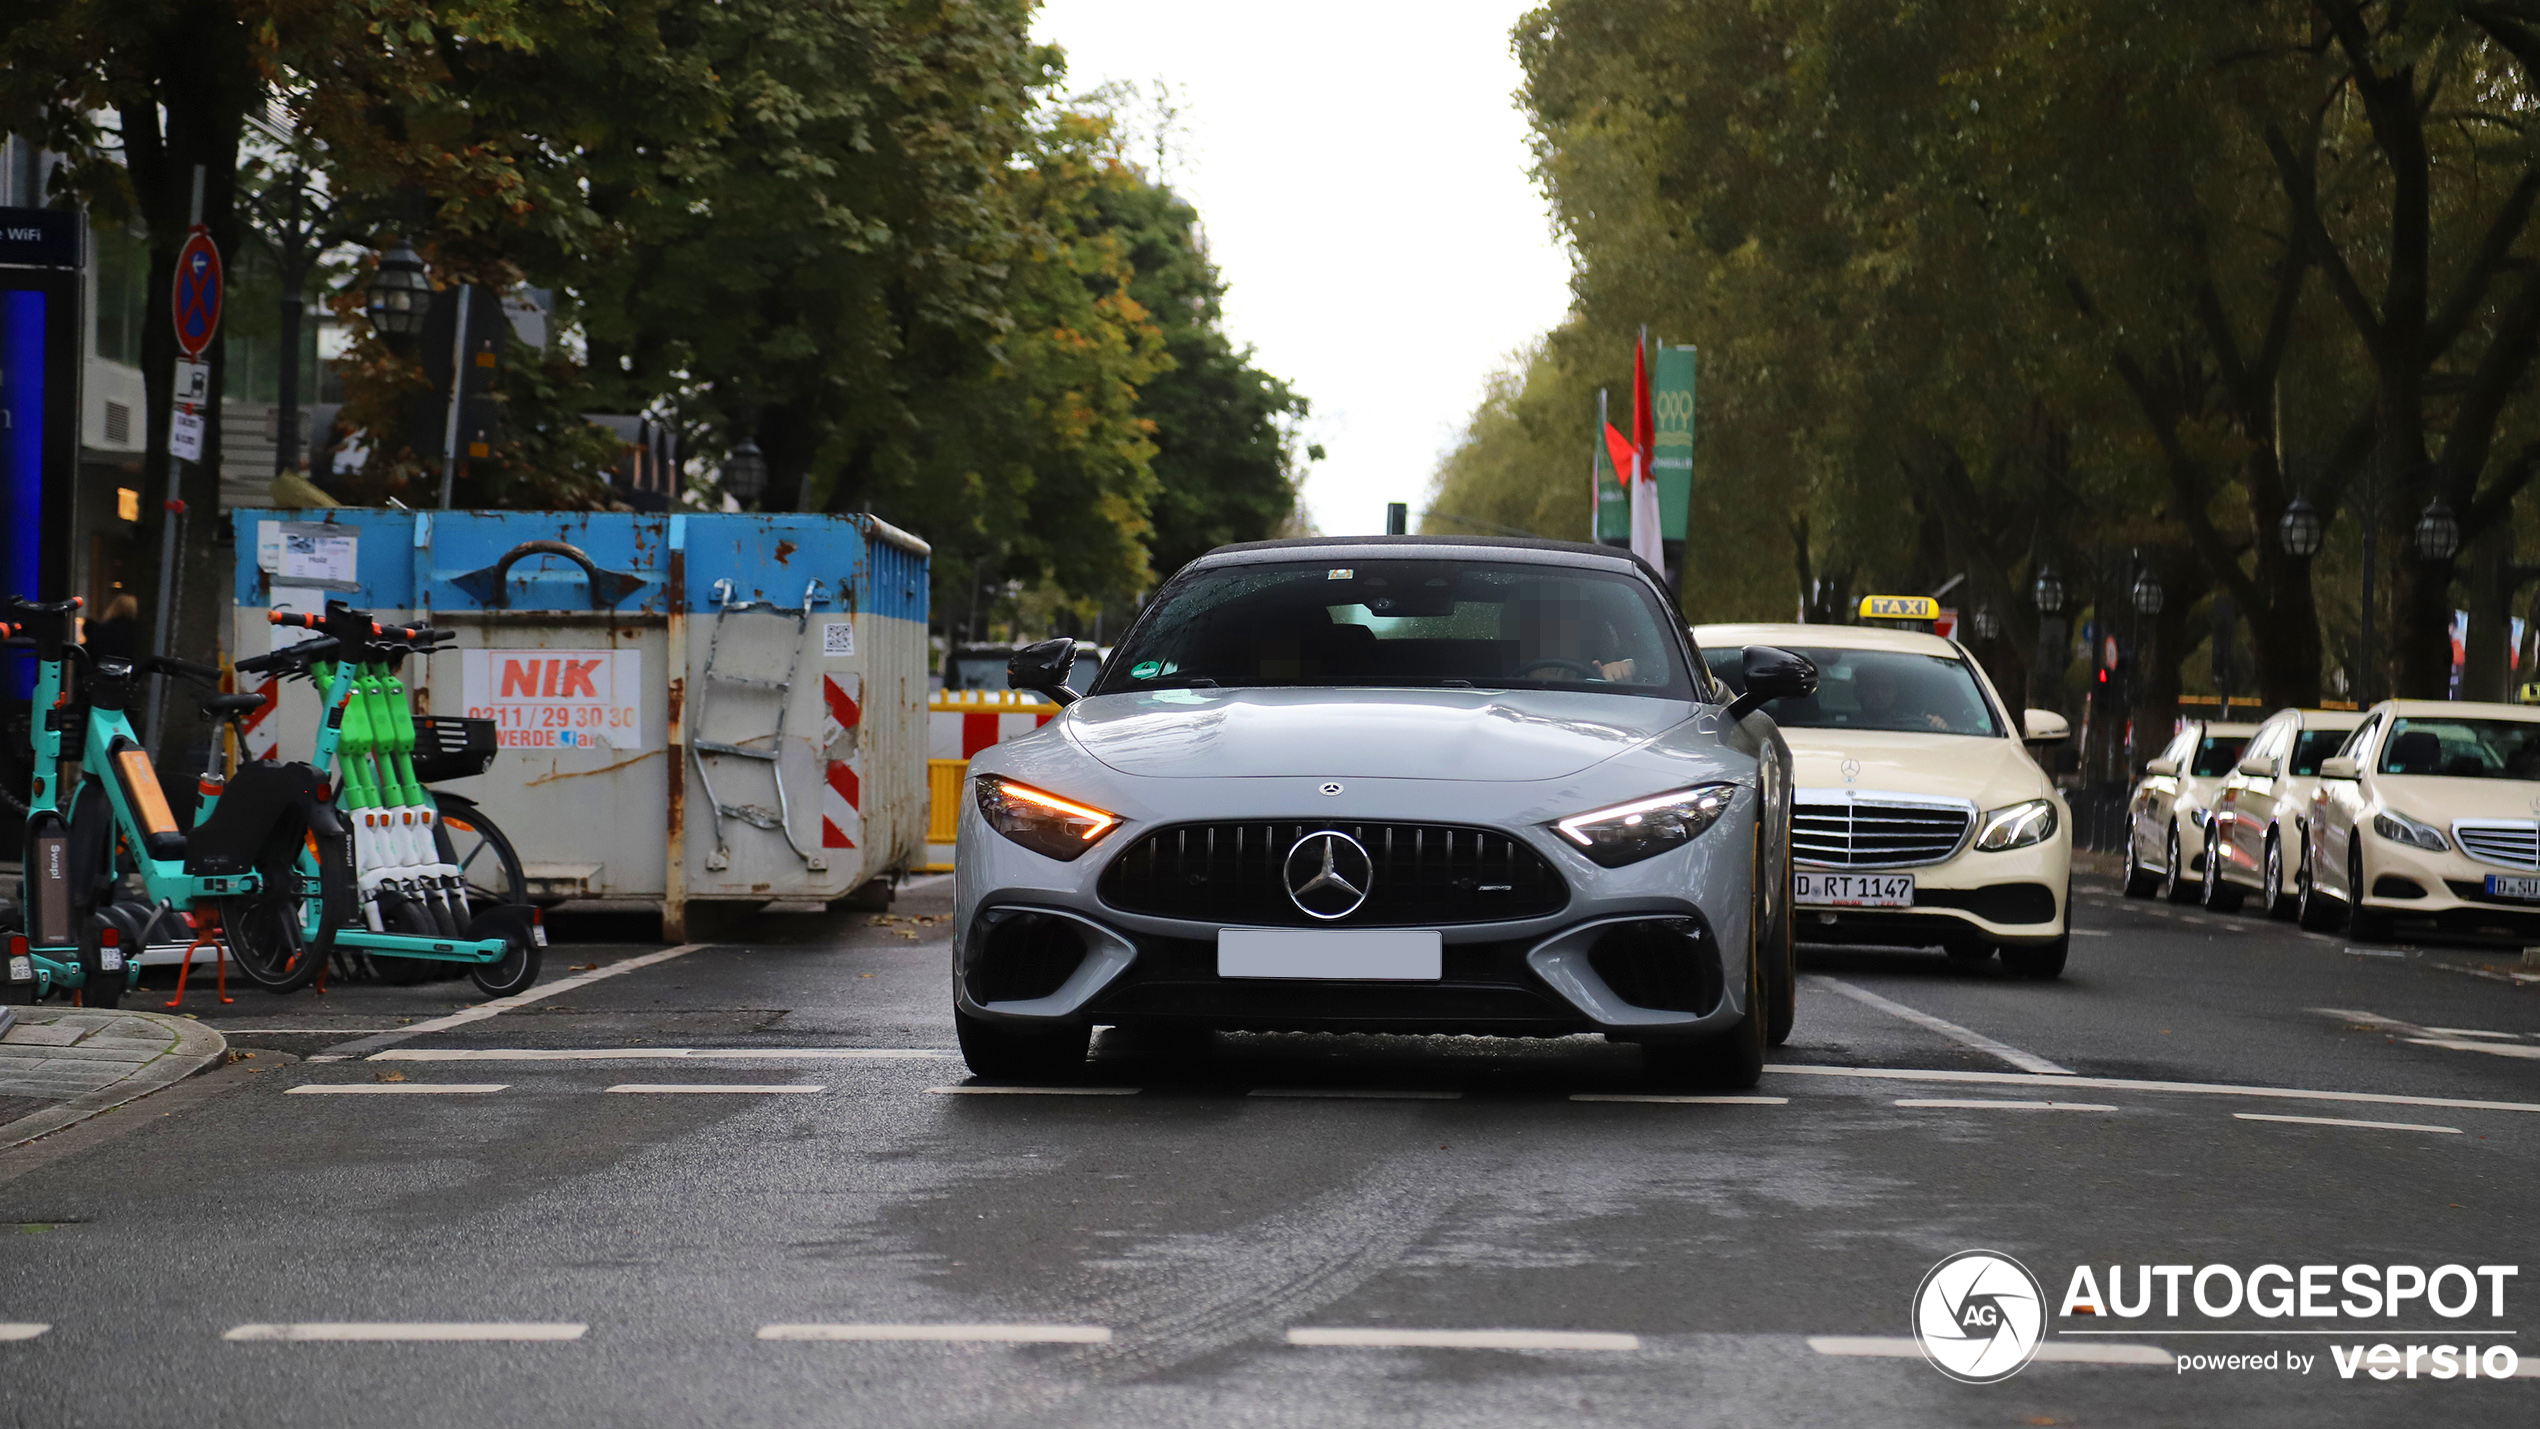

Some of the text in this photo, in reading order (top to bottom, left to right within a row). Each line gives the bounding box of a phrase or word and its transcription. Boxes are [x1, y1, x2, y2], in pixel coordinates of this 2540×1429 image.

[7, 228, 41, 241] WiFi
[1874, 600, 1926, 615] TAXI
[500, 660, 603, 697] NIK
[542, 706, 569, 727] 29
[575, 707, 603, 727] 30
[609, 707, 635, 727] 30
[1796, 876, 1910, 898] D RT 1147
[2497, 877, 2507, 894] D
